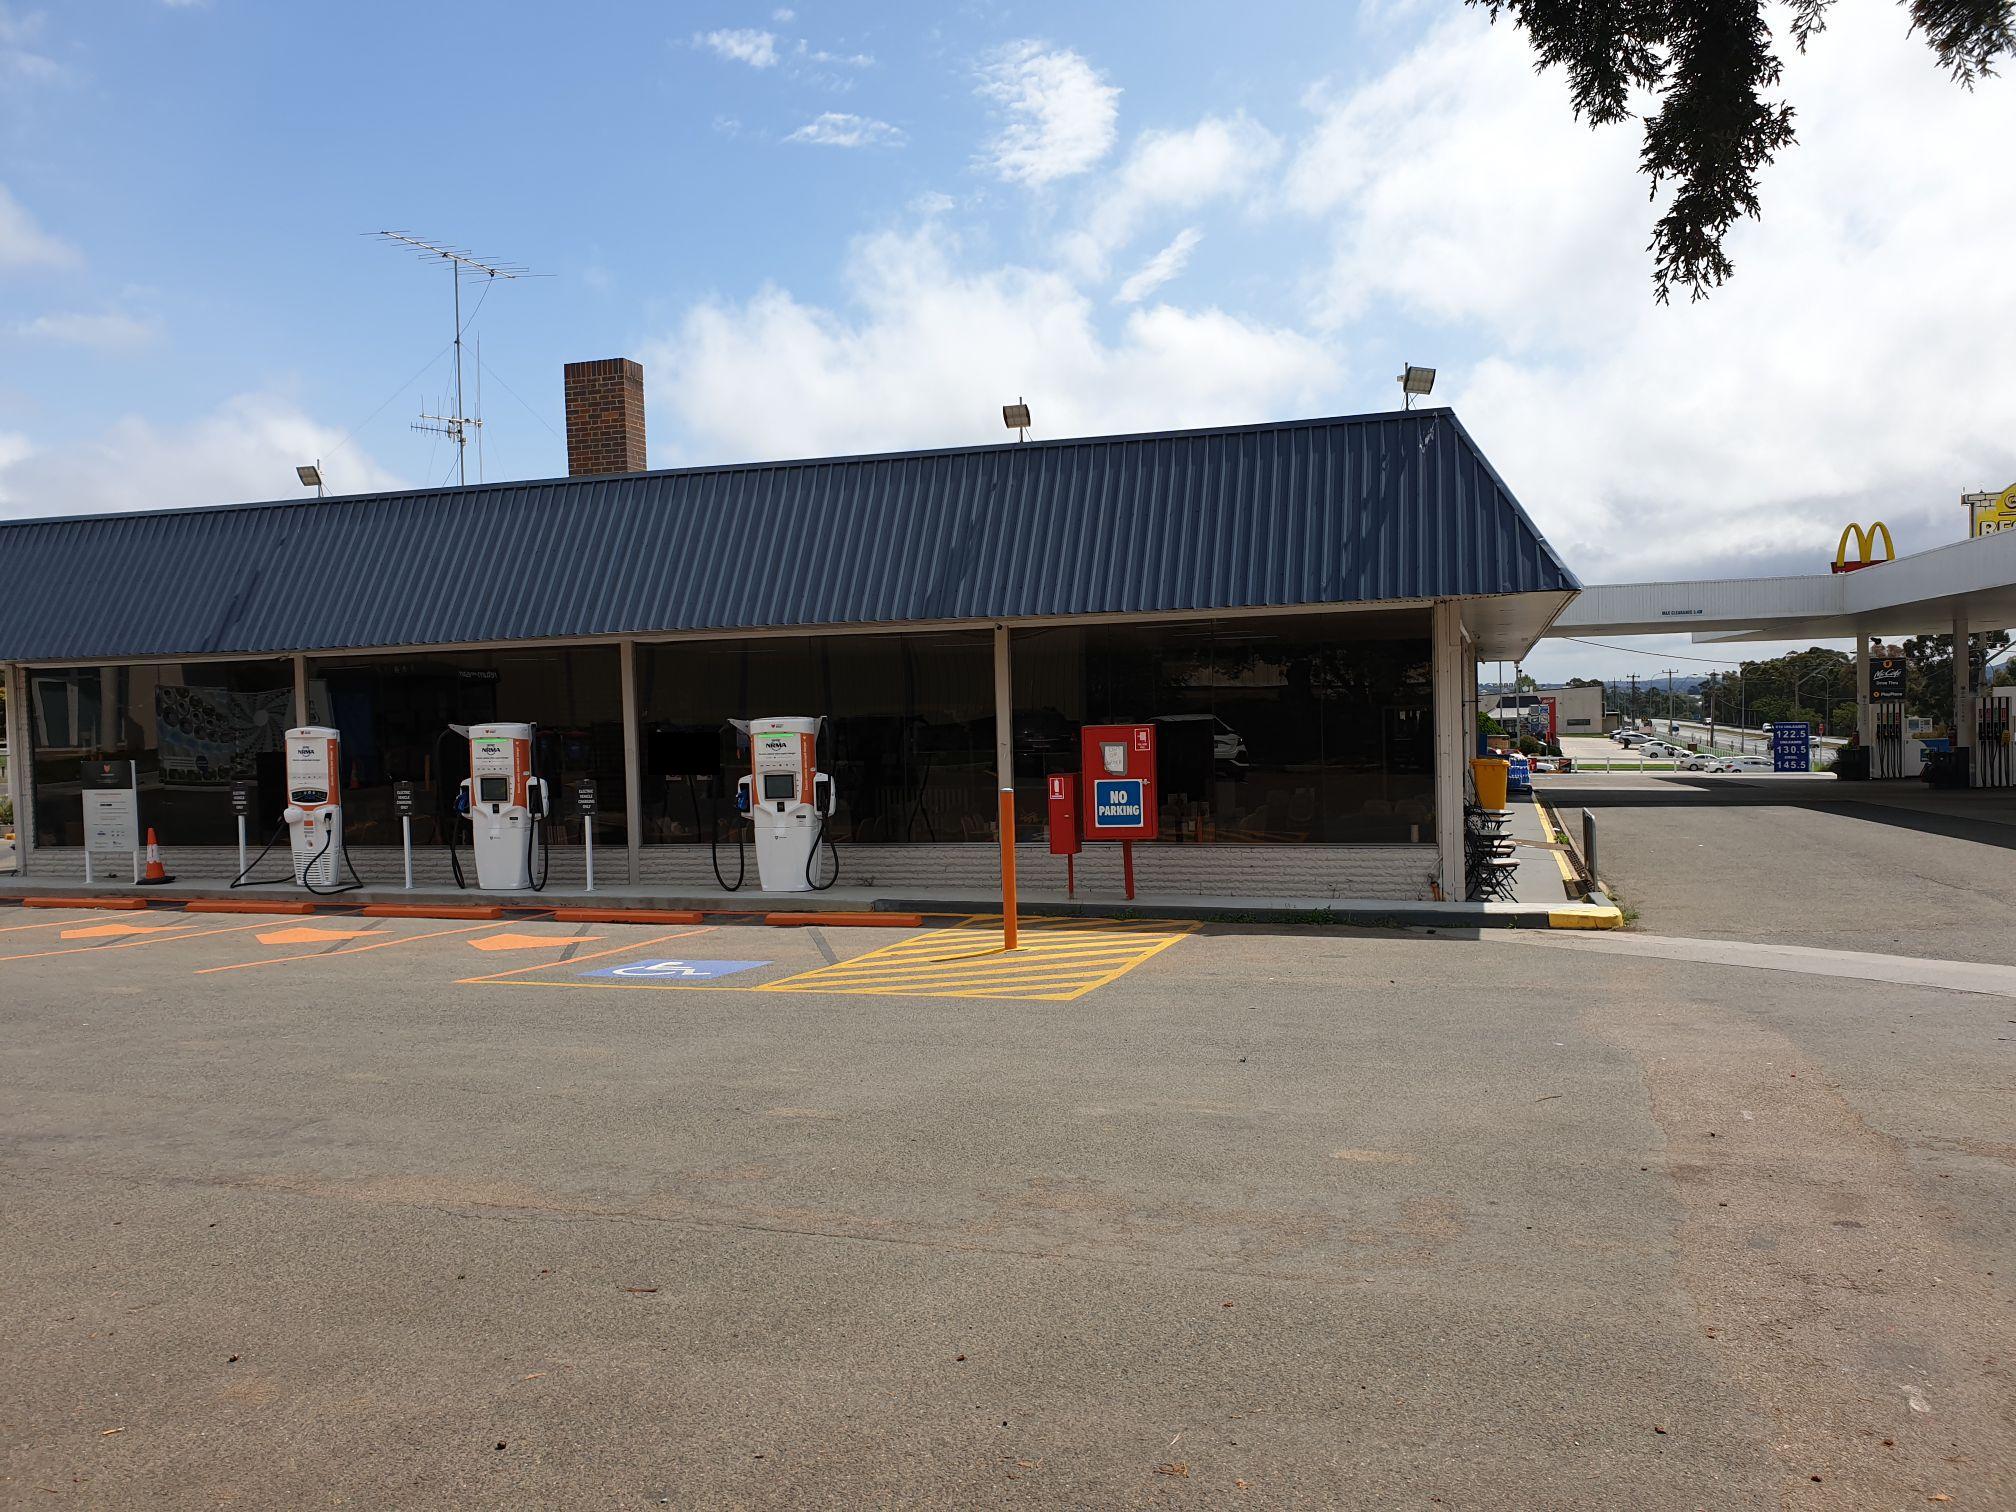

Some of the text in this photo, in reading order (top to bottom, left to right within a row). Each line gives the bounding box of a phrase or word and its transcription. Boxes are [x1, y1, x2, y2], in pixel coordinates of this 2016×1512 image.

[1776, 730, 1806, 738] 122.5
[1776, 745, 1807, 754] 130.5
[1776, 760, 1806, 769] 145.5
[1109, 790, 1128, 804] NO
[1098, 805, 1140, 816] PARKING
